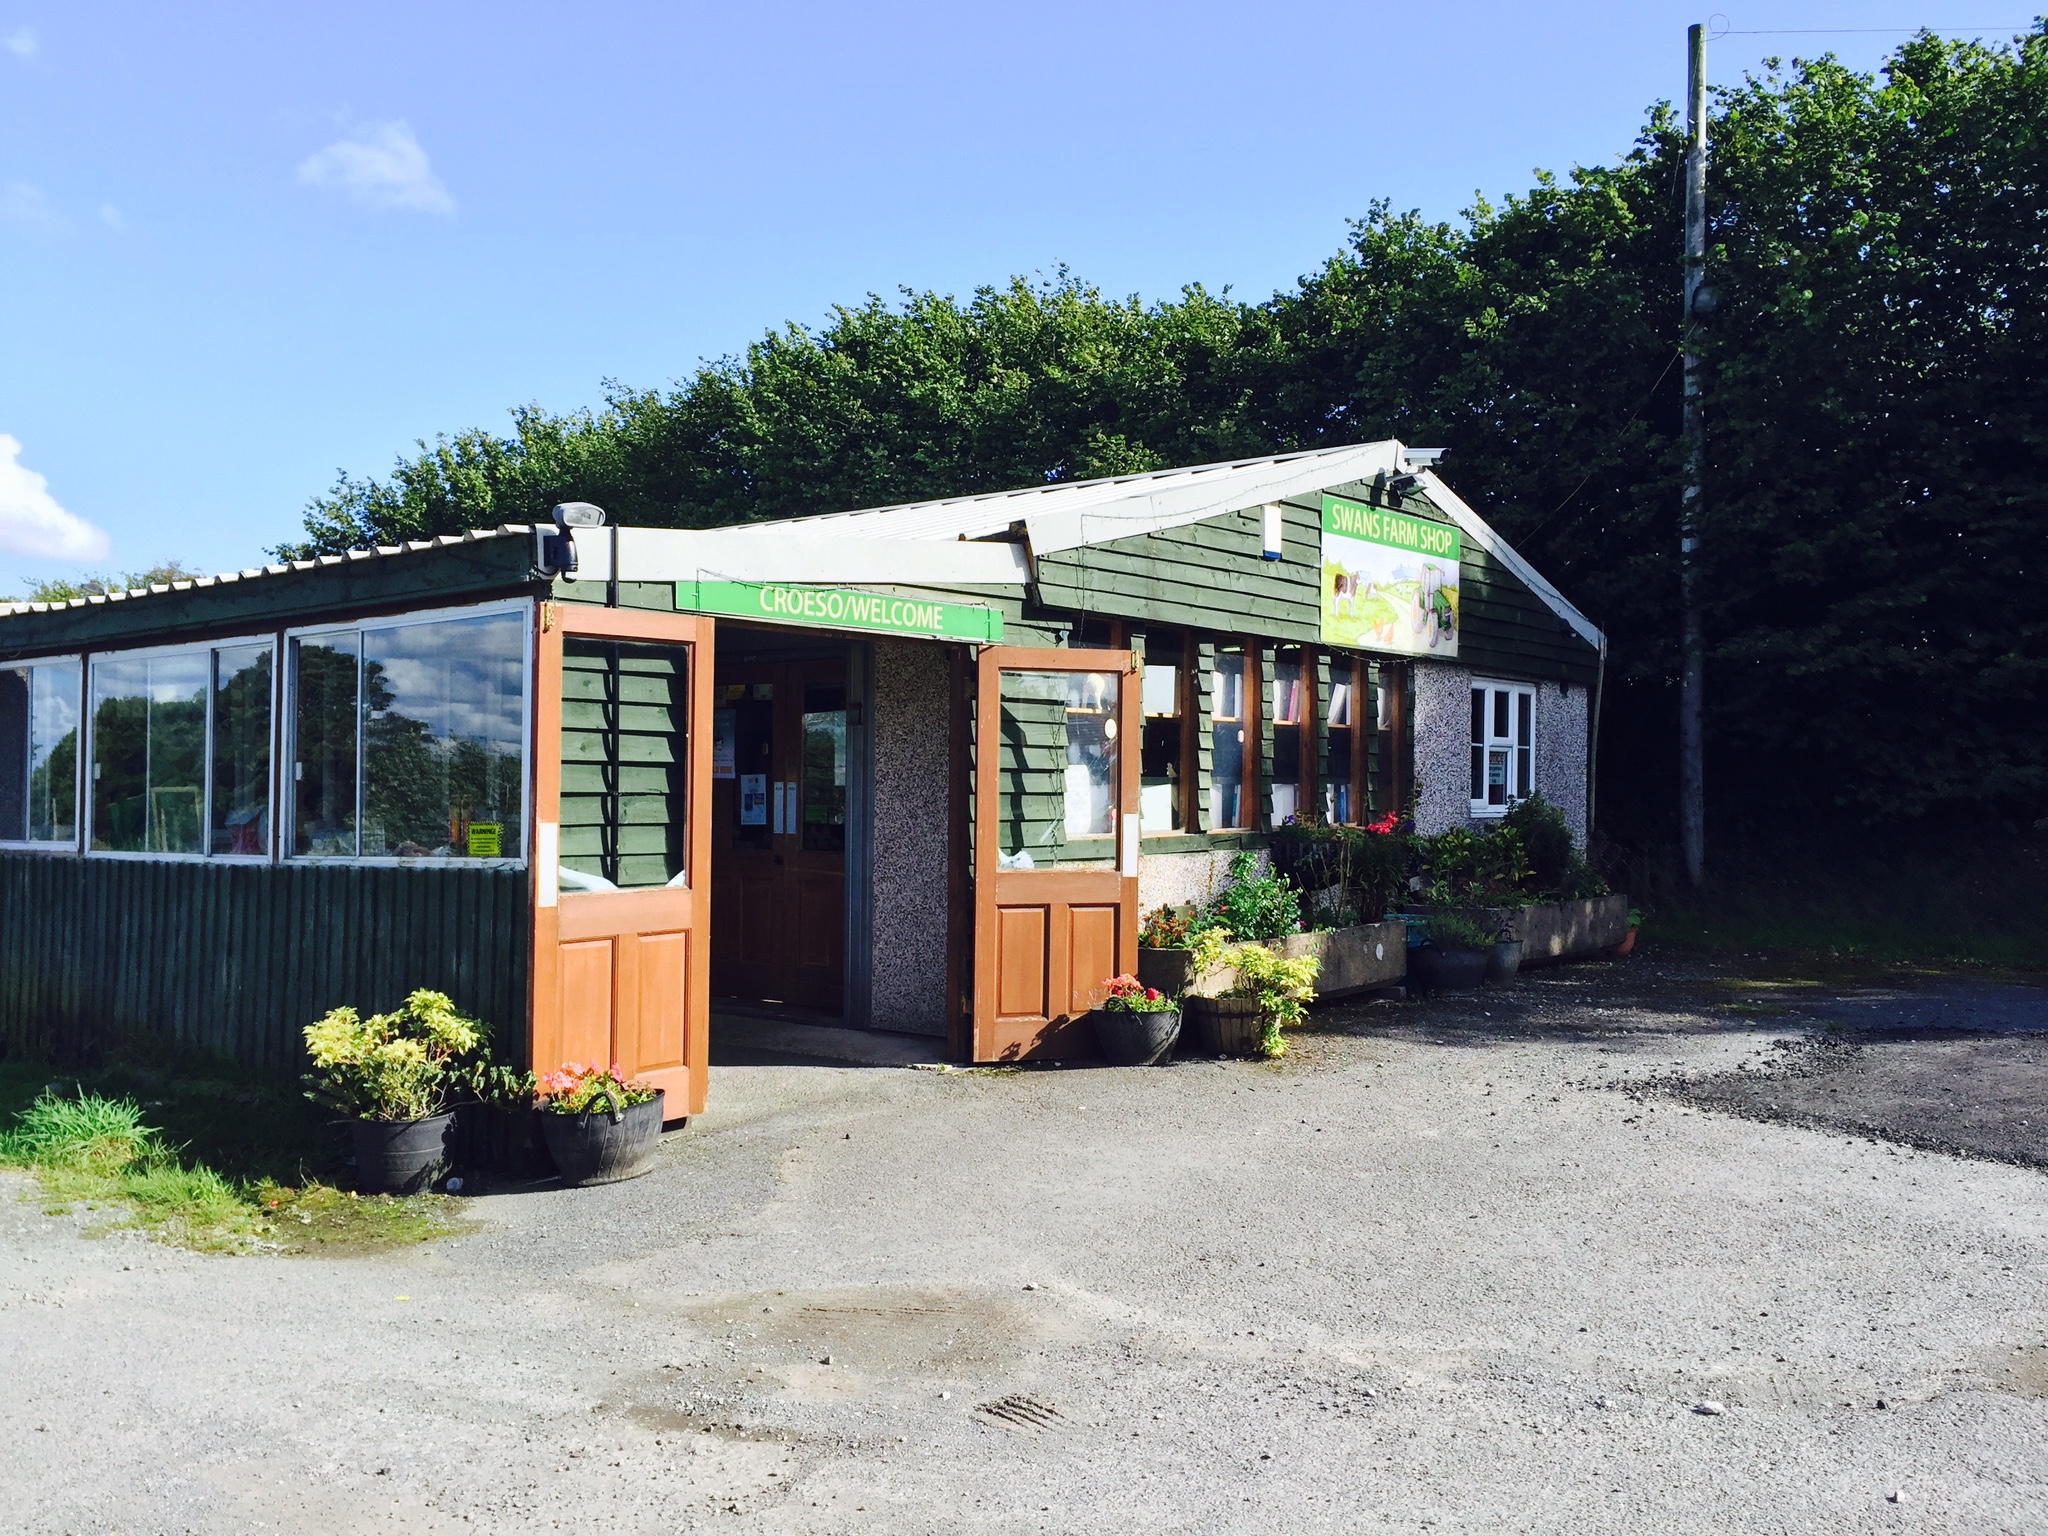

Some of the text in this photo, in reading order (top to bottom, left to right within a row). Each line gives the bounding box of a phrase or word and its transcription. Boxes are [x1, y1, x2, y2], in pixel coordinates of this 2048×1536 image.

[1332, 504, 1453, 555] SWANS FARM SHOP
[760, 587, 944, 630] CROESO/WELCOME
